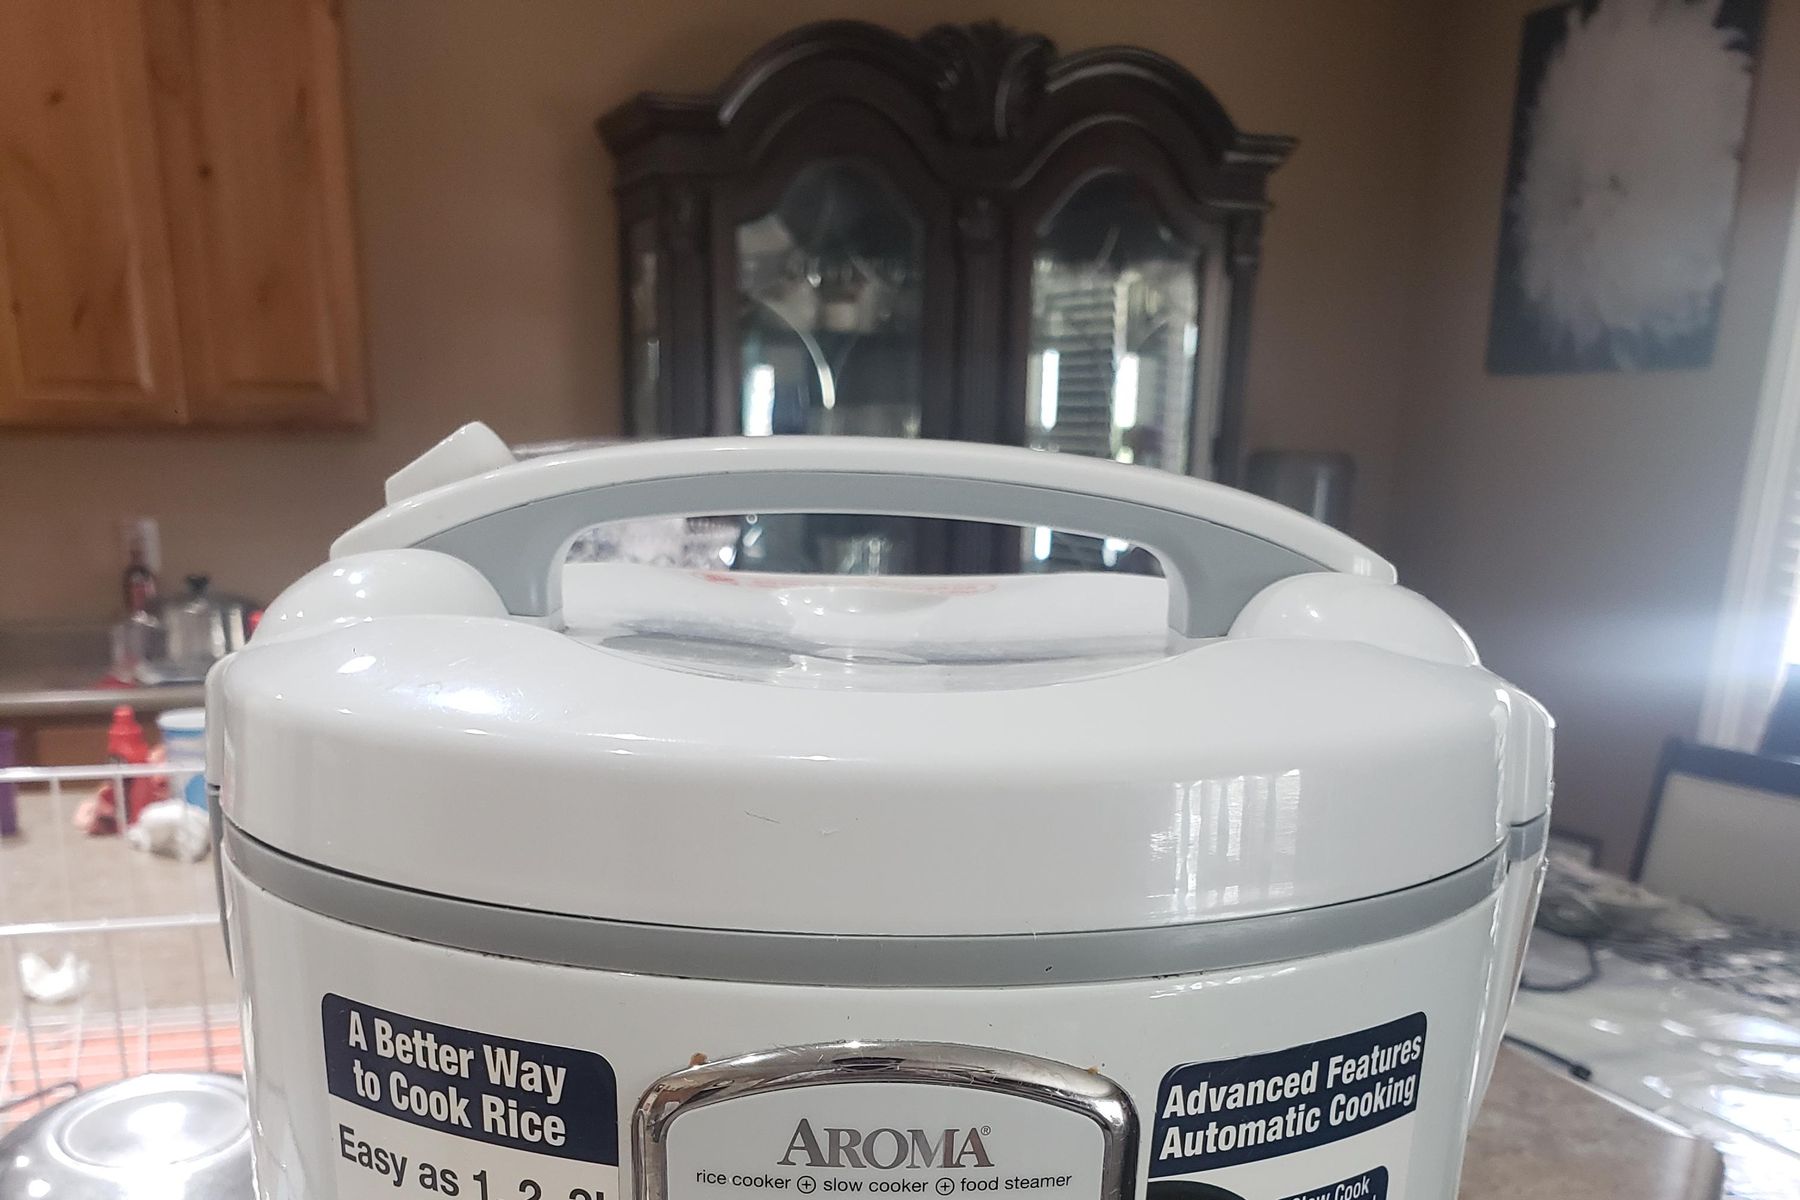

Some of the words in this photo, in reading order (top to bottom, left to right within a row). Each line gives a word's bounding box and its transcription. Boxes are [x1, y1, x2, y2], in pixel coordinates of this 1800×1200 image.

[349, 1010, 368, 1051] A
[374, 1017, 474, 1079] Better
[483, 1044, 567, 1104] Way
[1162, 1061, 1319, 1119] Advanced
[1326, 1034, 1421, 1089] Features
[353, 1059, 381, 1102] to
[389, 1070, 472, 1129] Cook
[481, 1093, 566, 1147] Rice
[1159, 1107, 1320, 1159] Automatic
[1329, 1073, 1416, 1125] Cooking
[339, 1123, 408, 1187] Easy
[419, 1162, 459, 1197] as
[695, 1170, 727, 1186] rice
[732, 1173, 791, 1190] cooker
[823, 1177, 863, 1193] slow
[869, 1177, 928, 1194] cooker
[960, 1176, 999, 1192] food
[1004, 1173, 1072, 1190] steamer
